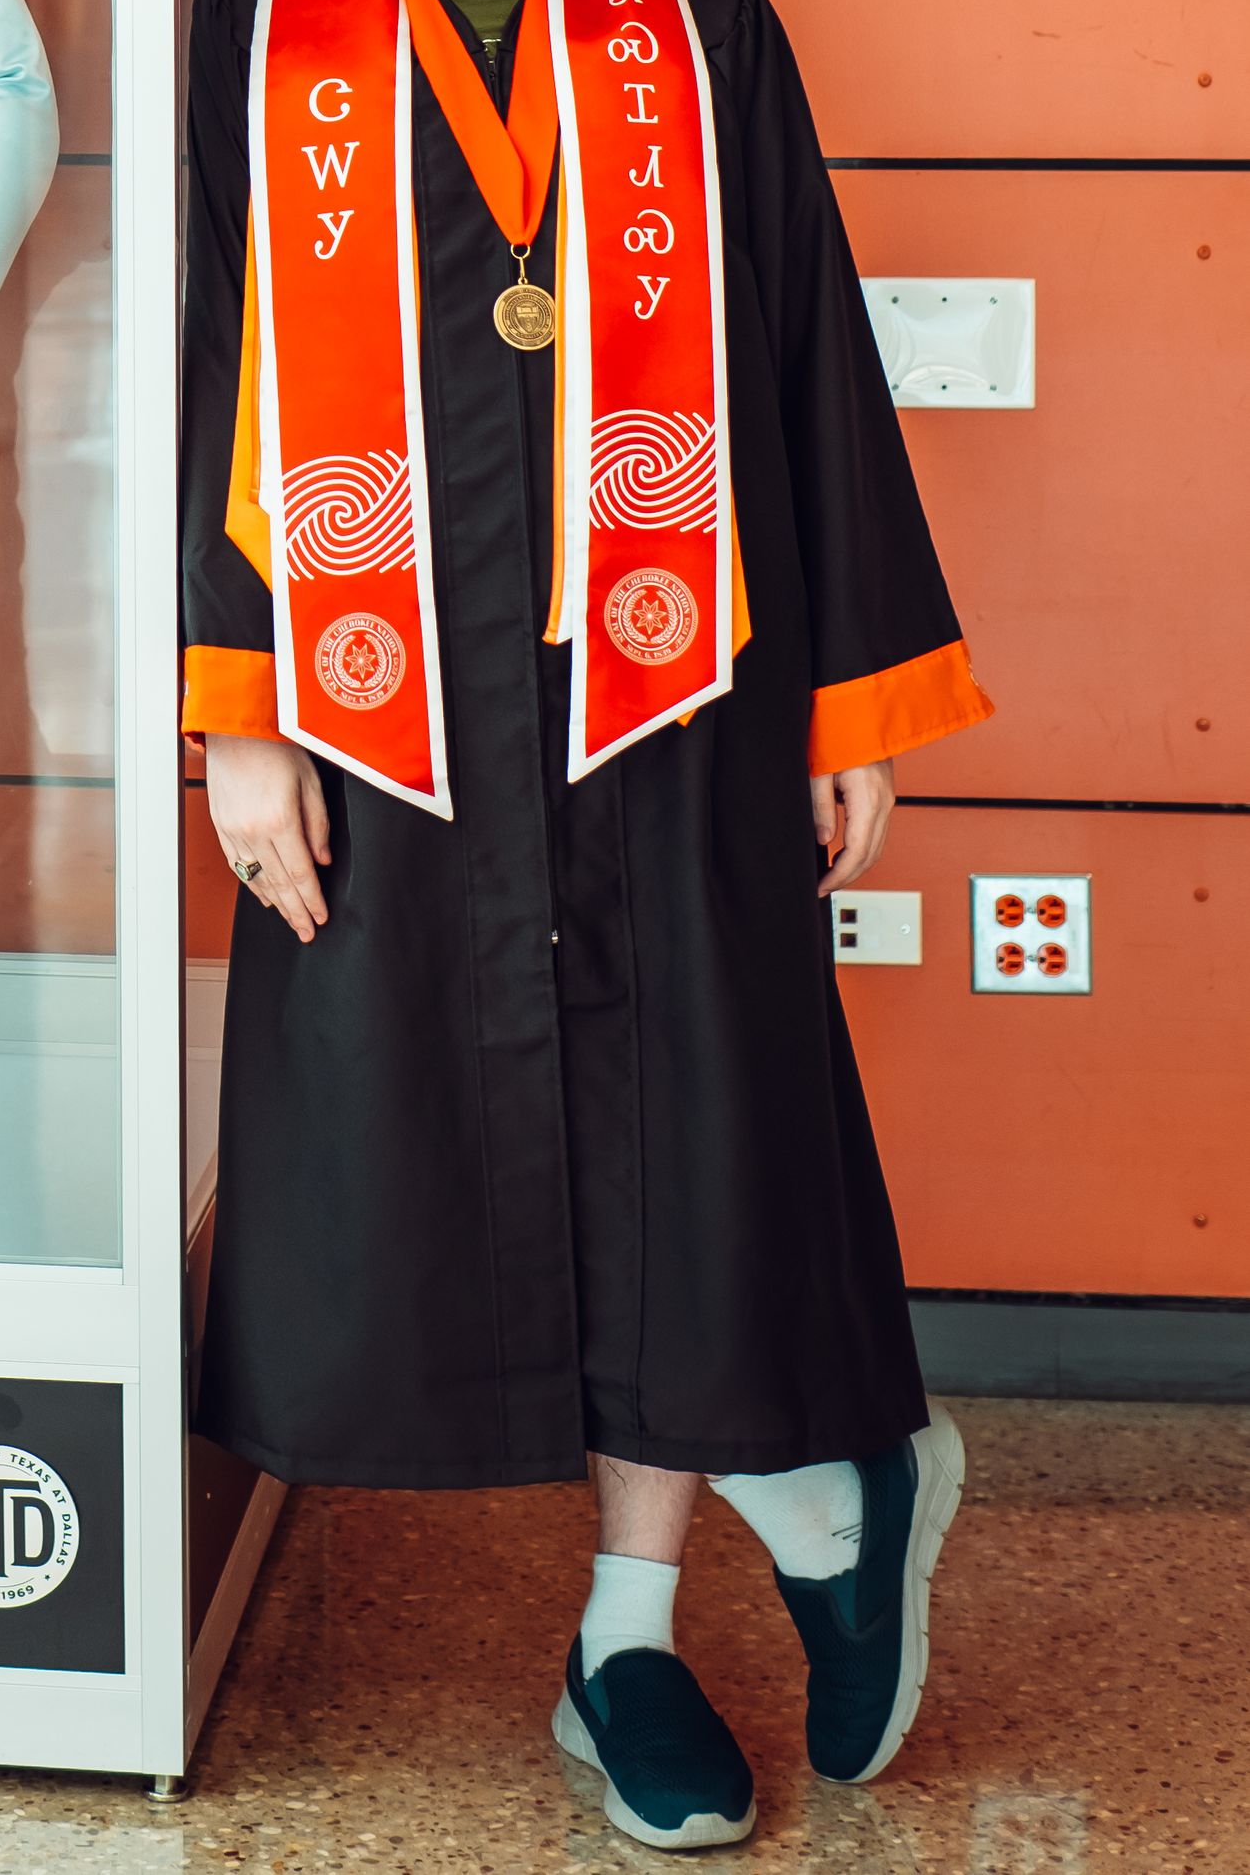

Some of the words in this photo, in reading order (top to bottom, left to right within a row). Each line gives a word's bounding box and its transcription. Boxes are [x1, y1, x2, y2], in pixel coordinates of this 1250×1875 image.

[670, 583, 690, 614] NATION
[376, 625, 398, 654] NATION
[10, 1453, 51, 1483] TEXAS
[52, 1489, 66, 1505] AT
[56, 1513, 72, 1566] DALLAS
[1, 1585, 34, 1600] 1969
